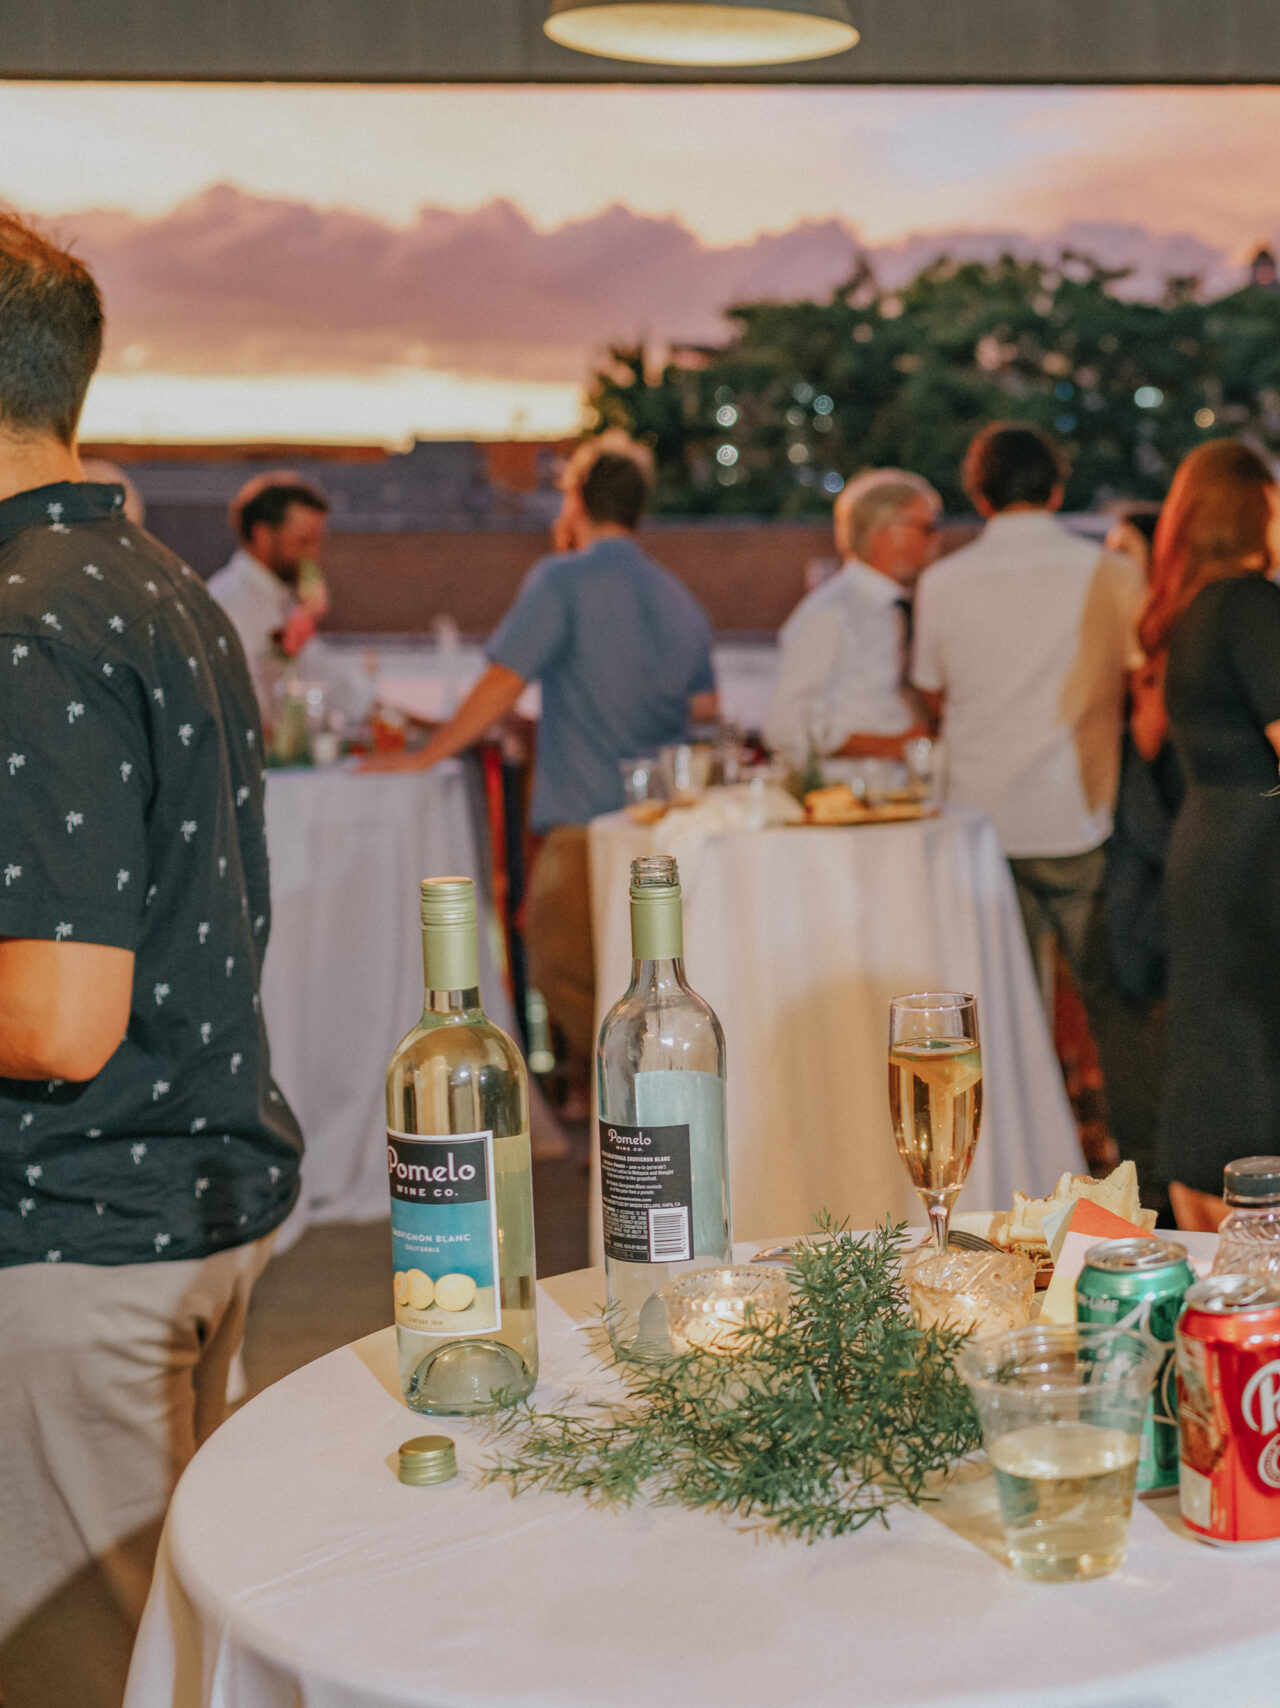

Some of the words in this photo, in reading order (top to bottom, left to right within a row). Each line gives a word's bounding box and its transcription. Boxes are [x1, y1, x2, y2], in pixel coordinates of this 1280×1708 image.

[607, 1128, 652, 1146] Pomelo
[386, 1145, 477, 1182] Pomelo
[396, 1184, 427, 1197] WINE
[433, 1188, 459, 1197] CO.
[435, 1234, 471, 1243] BLANC
